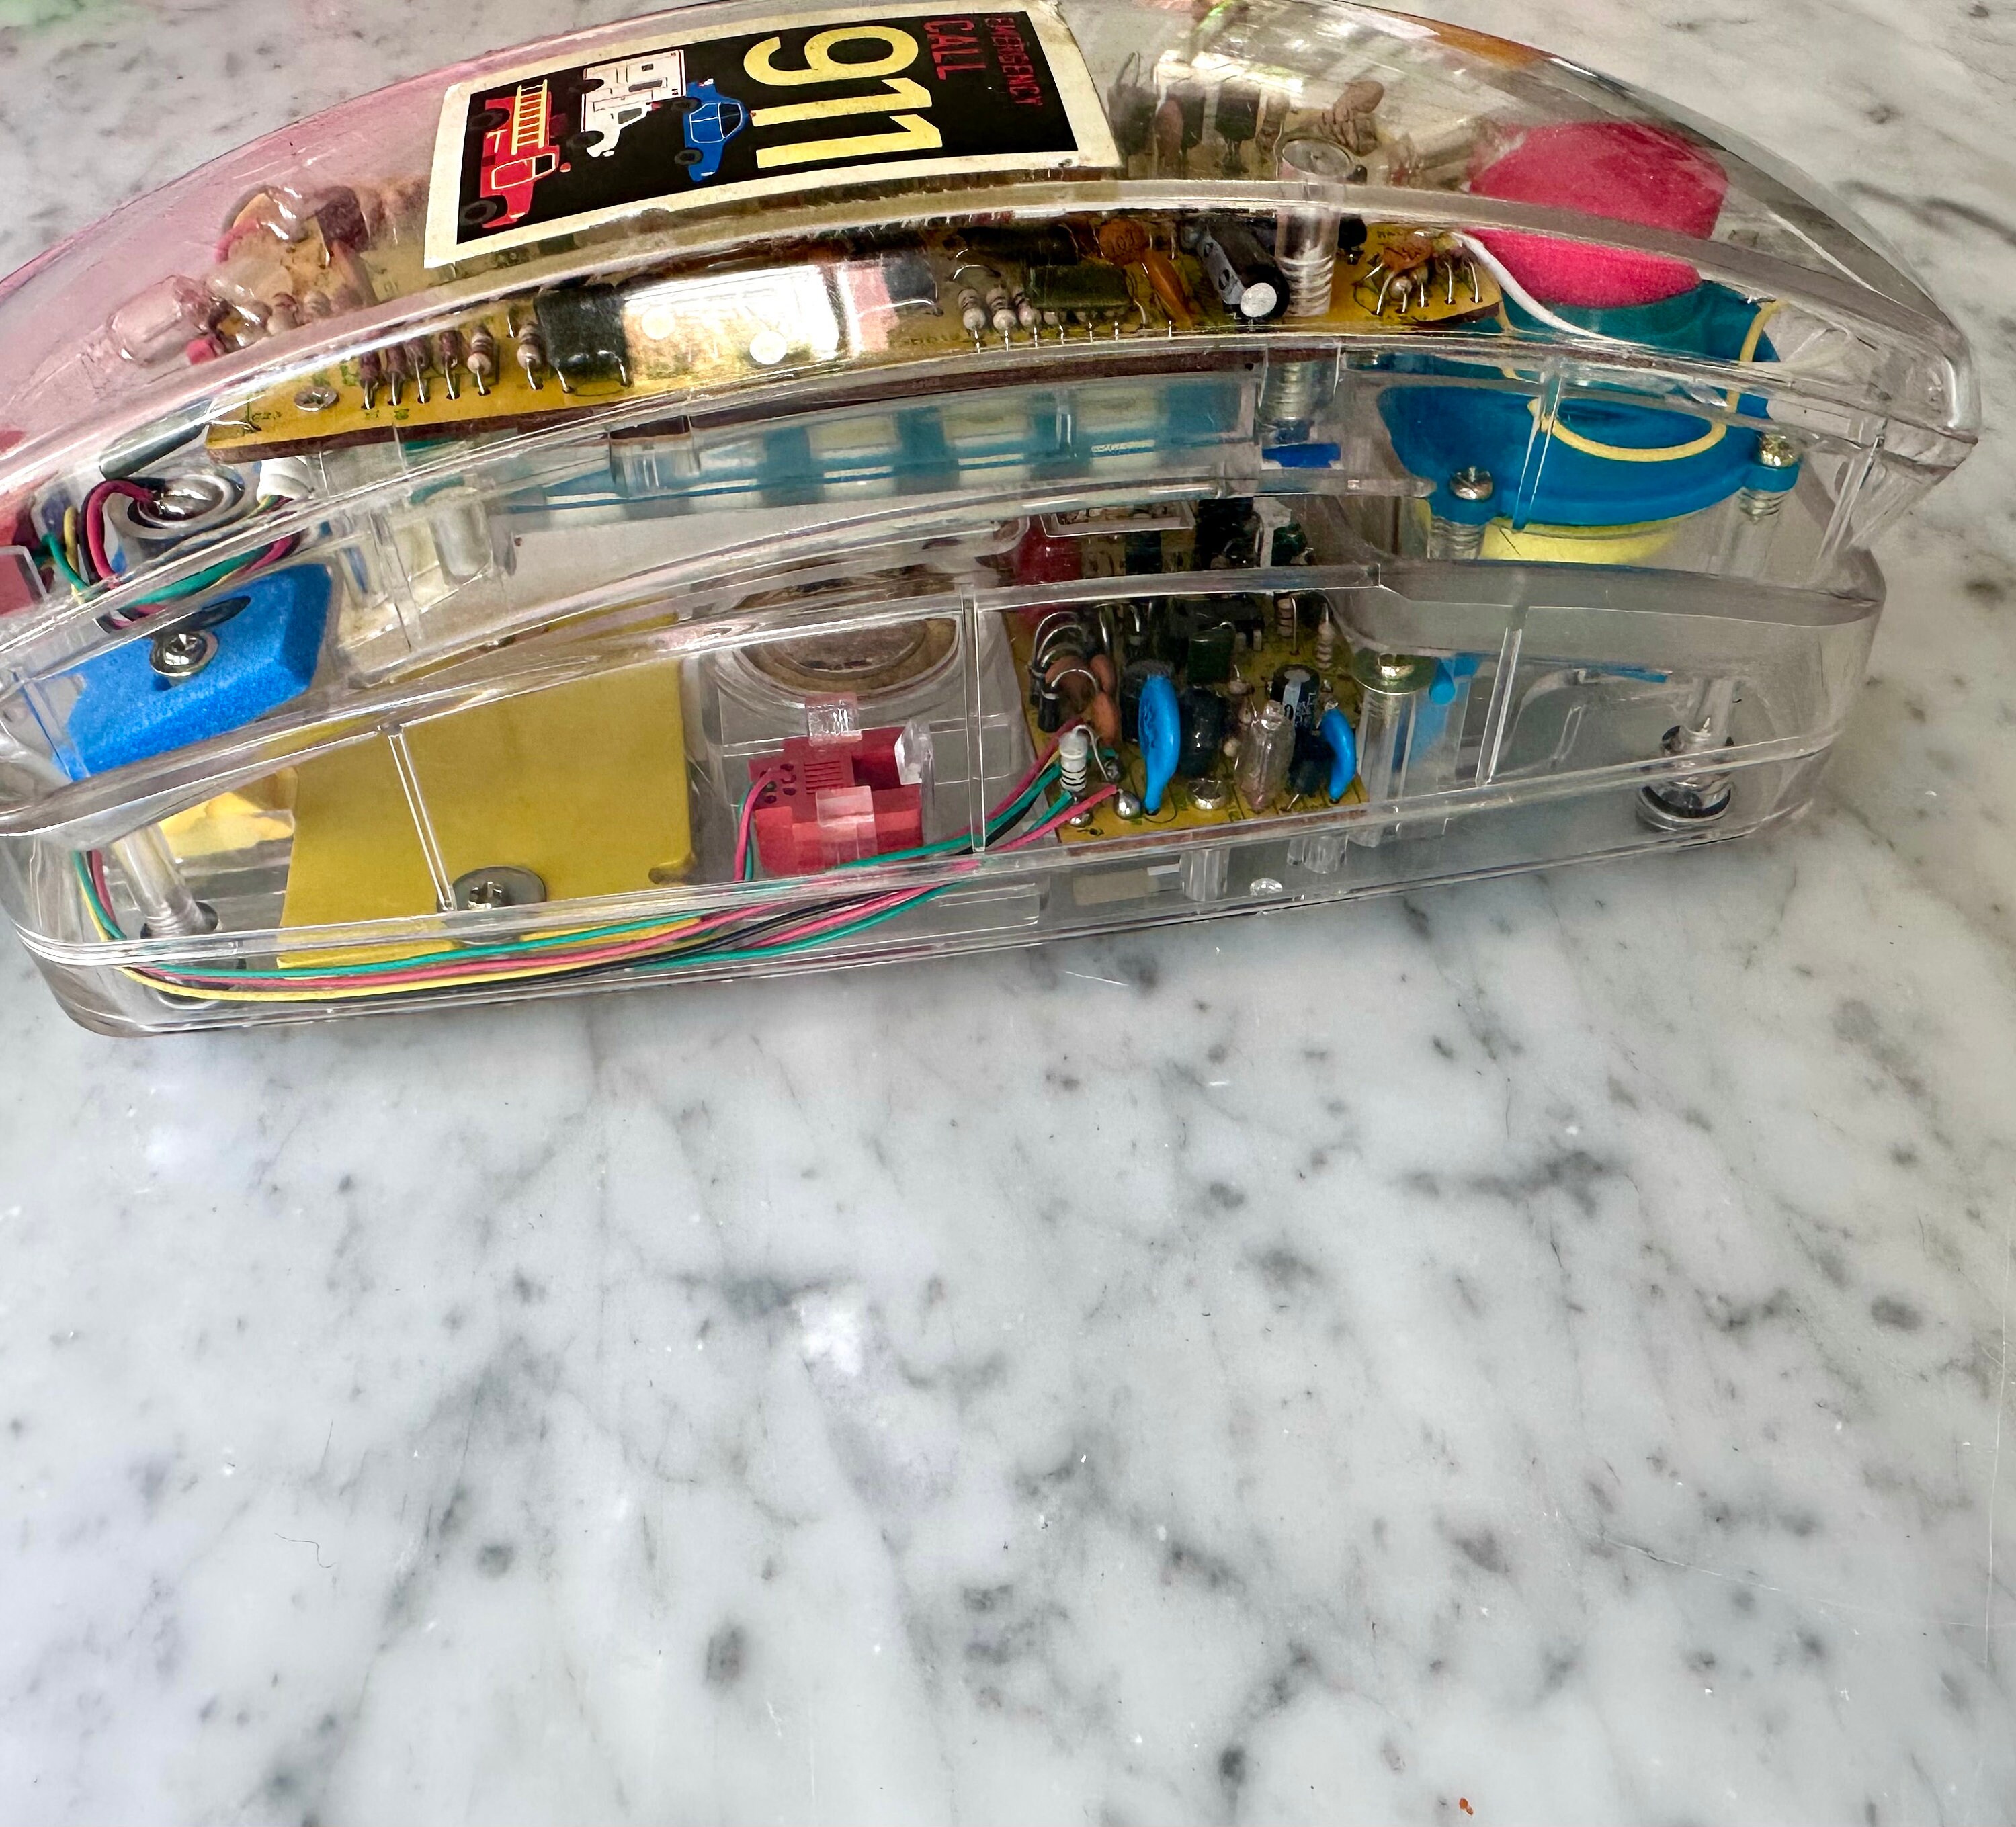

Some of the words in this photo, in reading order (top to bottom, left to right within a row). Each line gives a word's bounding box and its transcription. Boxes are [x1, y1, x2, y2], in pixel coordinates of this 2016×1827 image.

[923, 19, 987, 80] CALL
[984, 17, 1044, 105] EMERGENCY
[743, 25, 943, 169] 911
